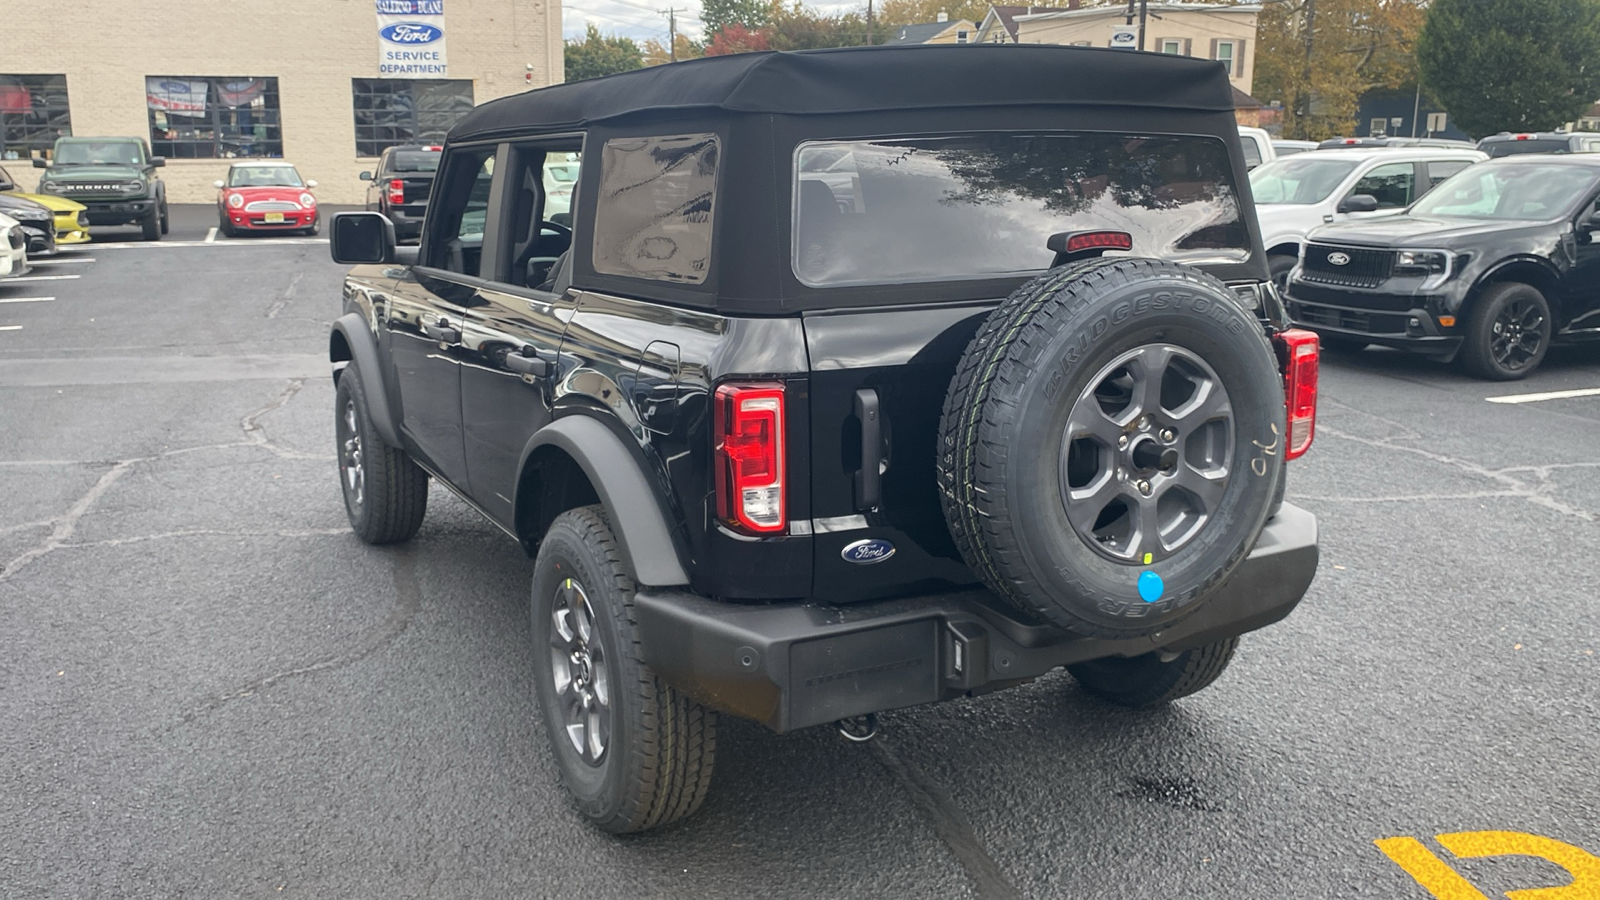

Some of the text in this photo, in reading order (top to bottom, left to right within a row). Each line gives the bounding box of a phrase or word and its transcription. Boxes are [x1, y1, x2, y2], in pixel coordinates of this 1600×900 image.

[391, 24, 432, 42] Ford
[386, 51, 440, 61] SERVICE
[380, 64, 447, 73] DEPARTMENT
[1042, 289, 1246, 400] BRIDGESTONE
